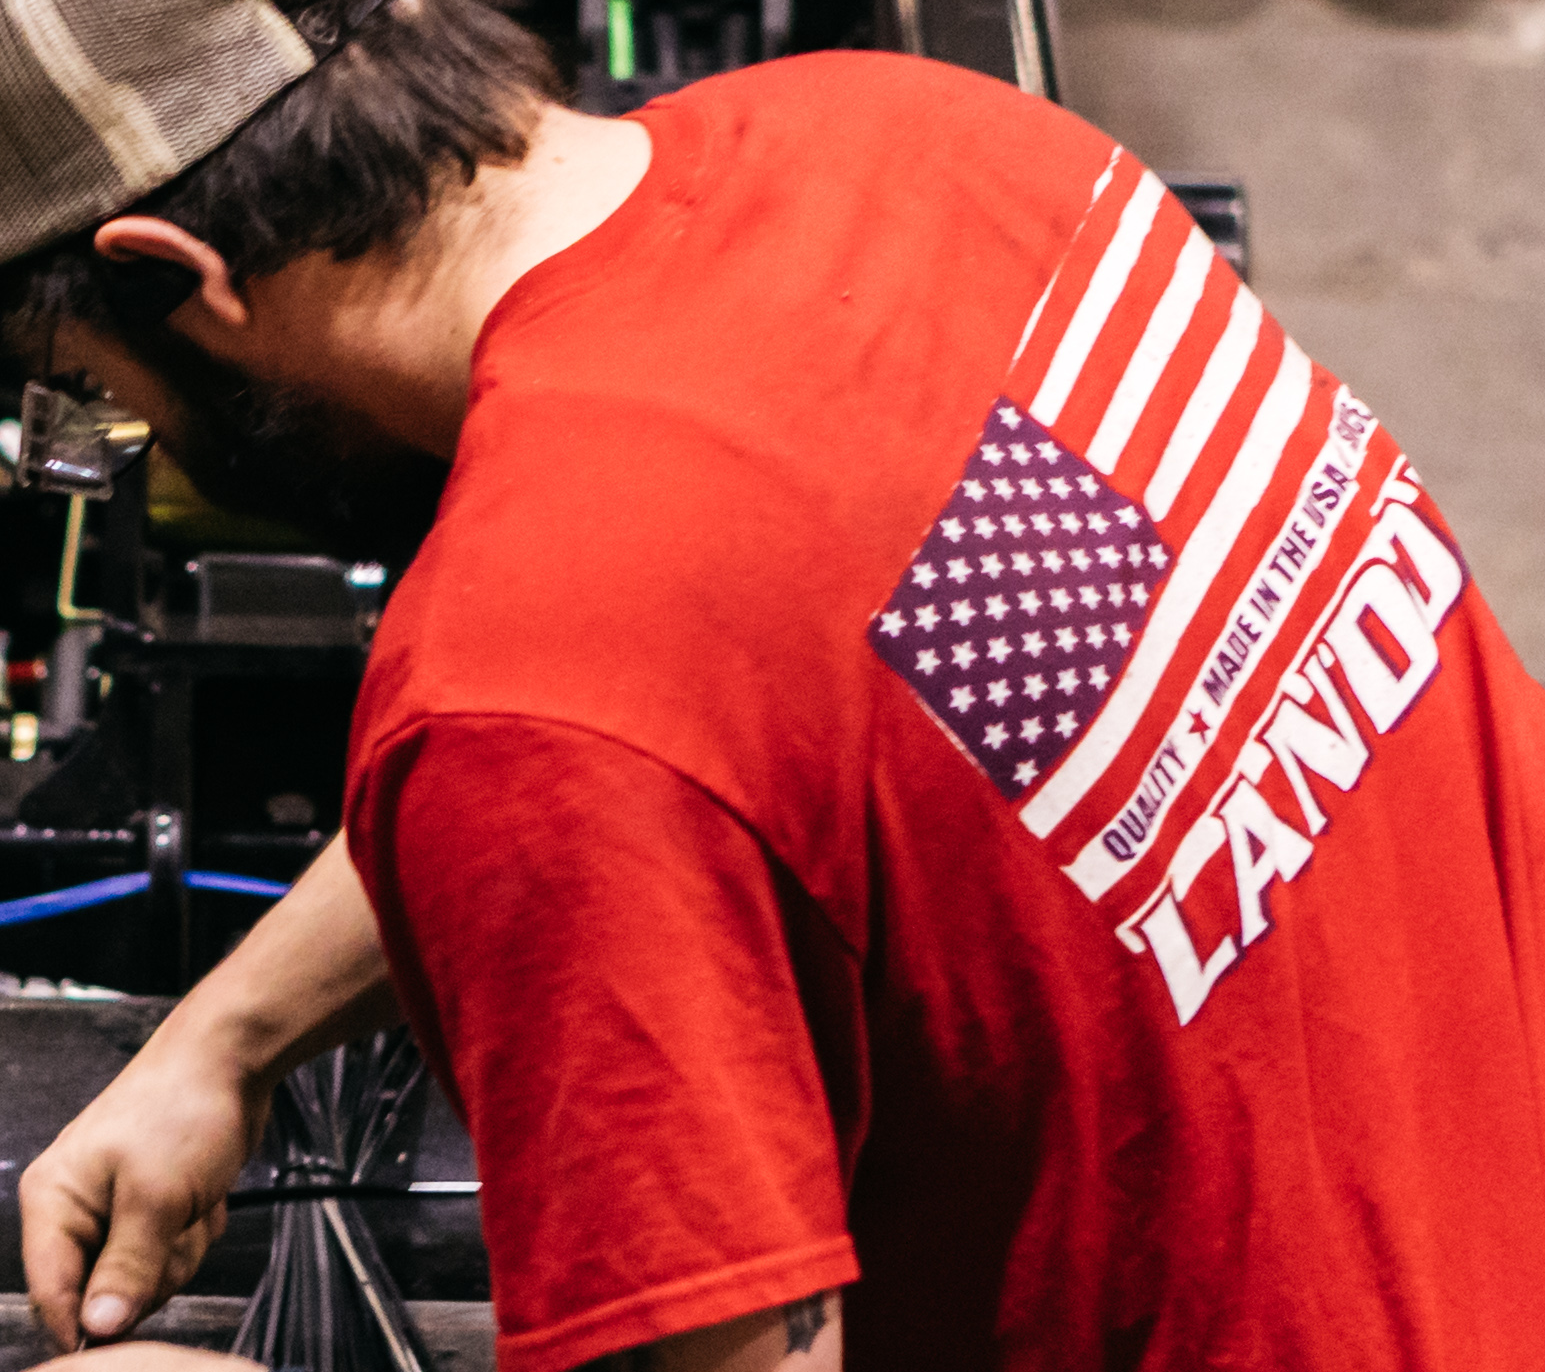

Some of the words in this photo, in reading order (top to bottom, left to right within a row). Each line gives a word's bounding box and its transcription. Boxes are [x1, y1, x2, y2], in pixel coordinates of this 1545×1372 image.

[1102, 739, 1186, 862] QUALITY
[1201, 613, 1262, 707] MADE
[1249, 579, 1281, 623] IN
[1269, 521, 1316, 584] THE
[1303, 463, 1349, 529] USA
